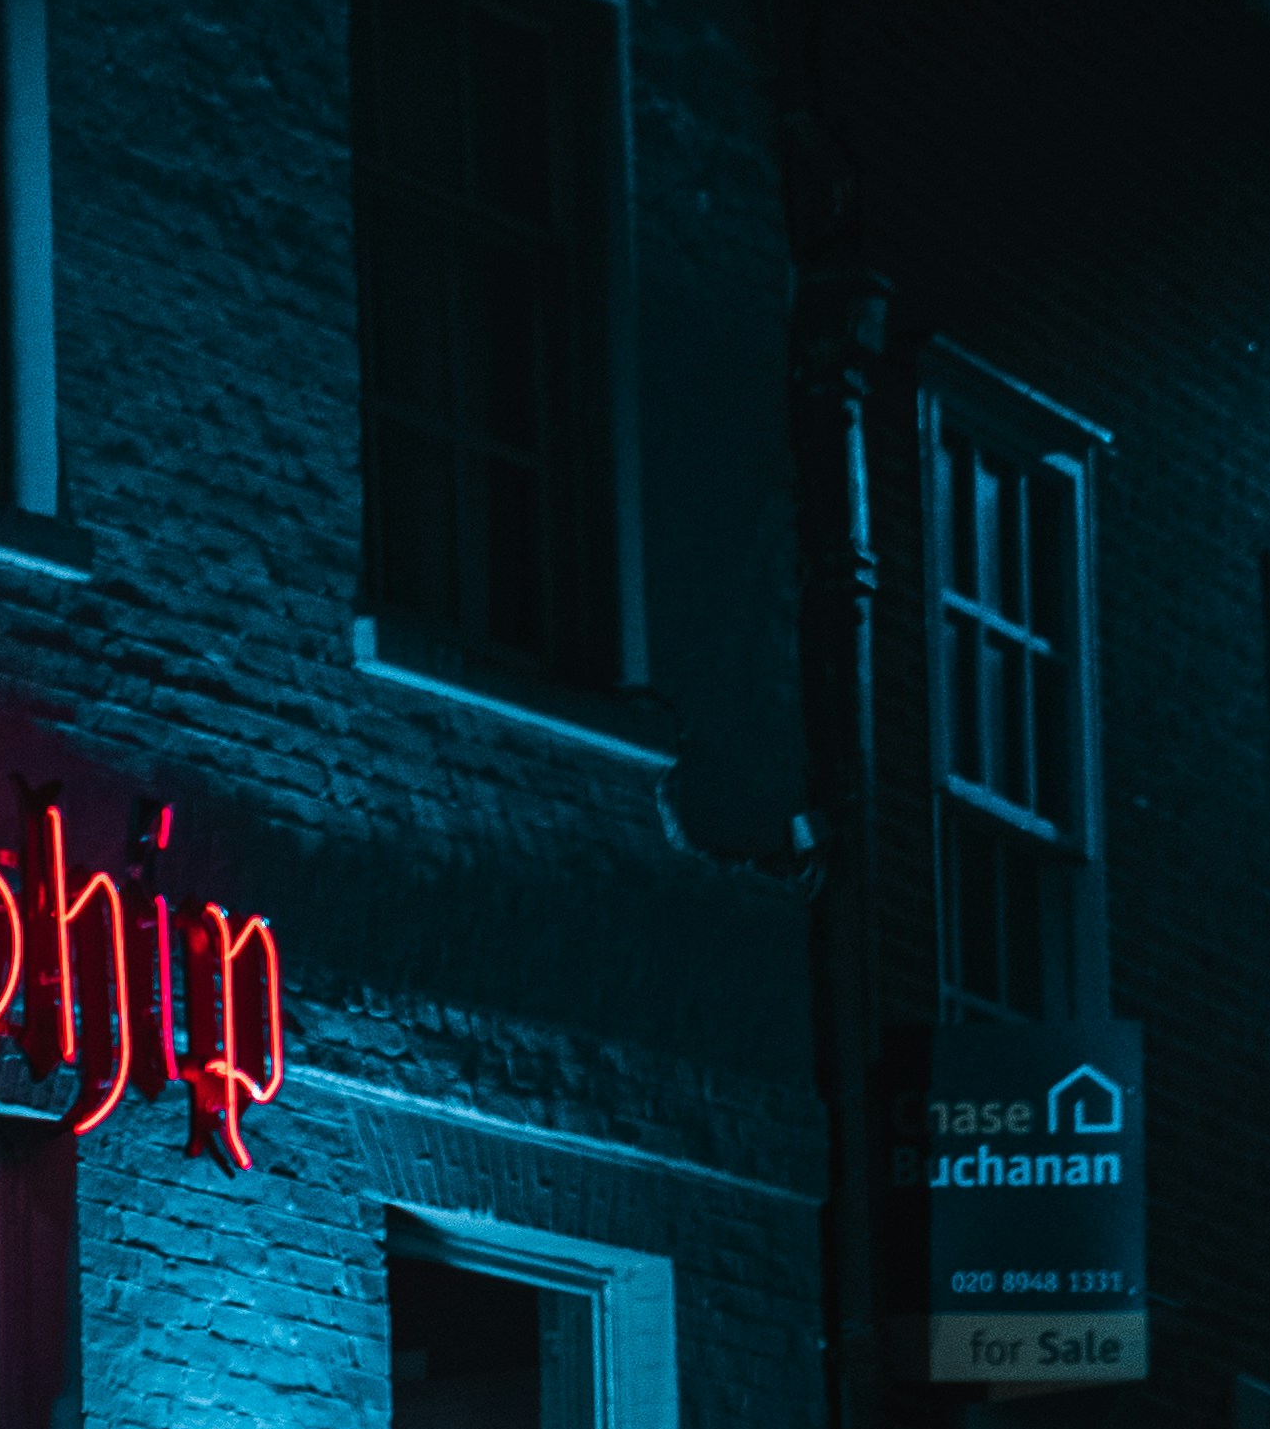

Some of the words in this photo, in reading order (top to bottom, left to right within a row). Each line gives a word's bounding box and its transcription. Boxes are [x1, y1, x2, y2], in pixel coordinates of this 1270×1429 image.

[951, 1271, 994, 1293] 020
[970, 1329, 1022, 1365] for
[1037, 1328, 1124, 1365] Sale
